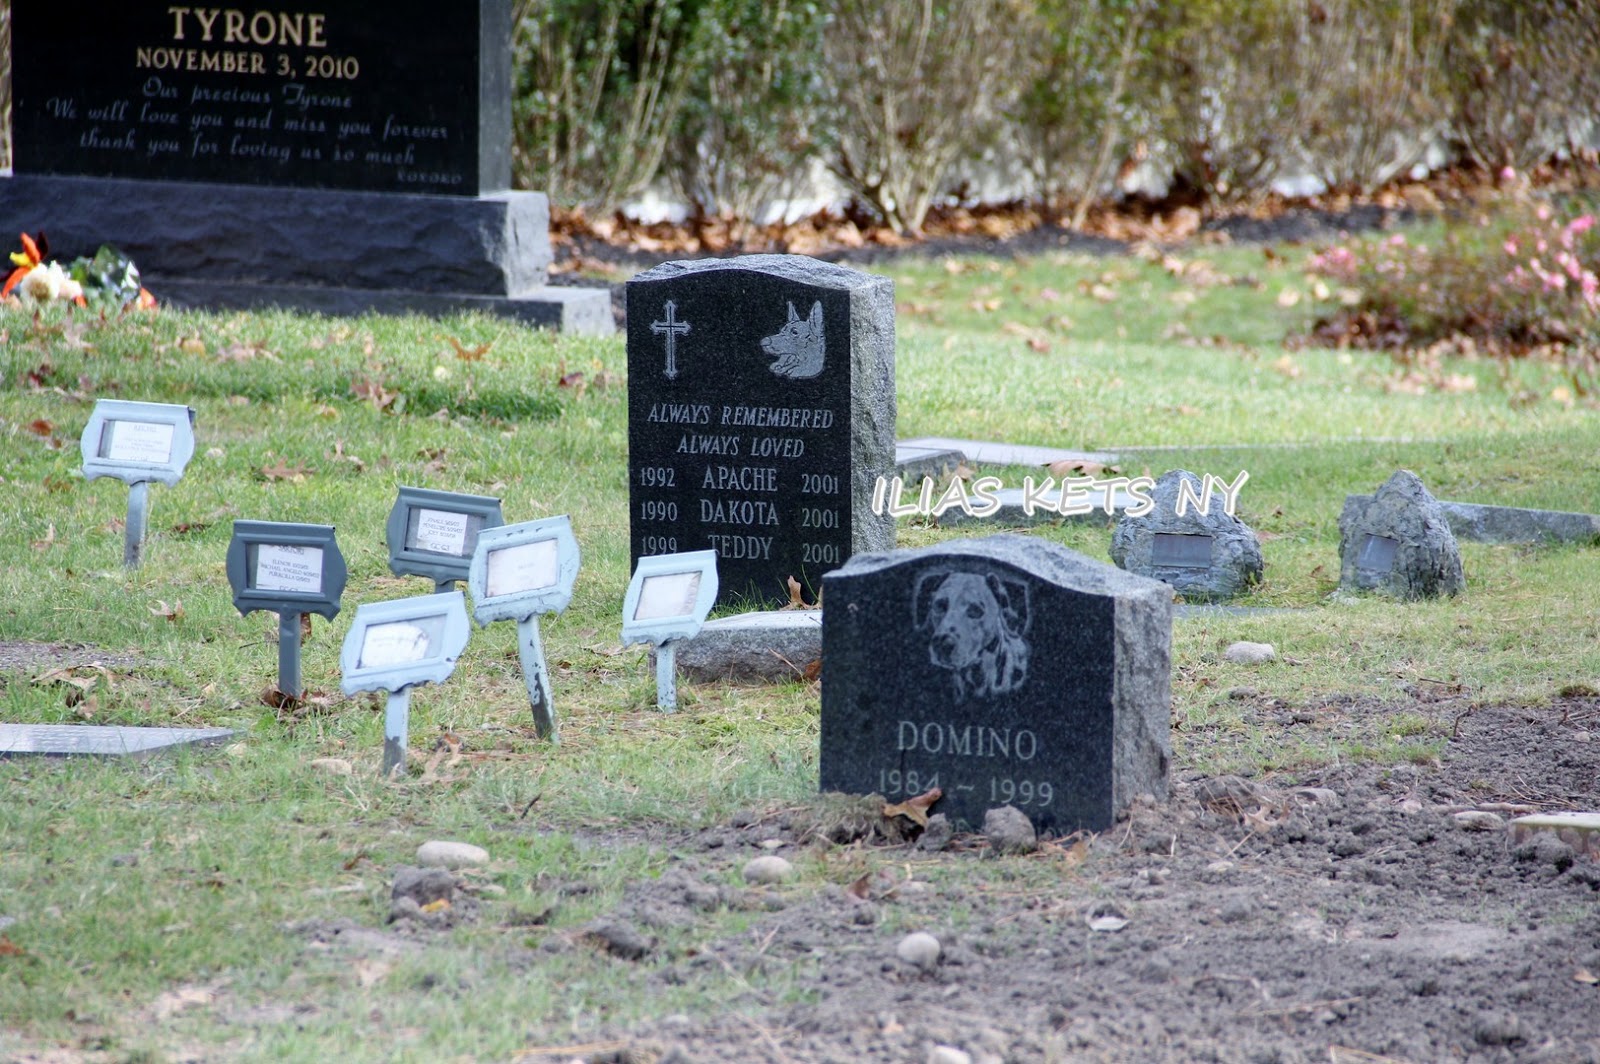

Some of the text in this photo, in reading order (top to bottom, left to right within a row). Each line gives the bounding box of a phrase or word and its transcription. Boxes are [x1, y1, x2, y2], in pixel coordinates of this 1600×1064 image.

[168, 6, 327, 48] TYRONE
[136, 46, 360, 80] NOVEMBER 3, 2010
[142, 76, 353, 112] Our precious Tyrone
[46, 96, 448, 141] We will love you and miss you forever
[79, 127, 415, 165] thank you for loving us so much
[646, 403, 834, 429] ALWAYS REMEMBERED
[676, 434, 805, 458] ALWAYS LOVED
[640, 464, 839, 495] 1992 APACHE 2001
[641, 498, 839, 529] 1990 DAKOTA 2001
[642, 534, 840, 564] 1999 TEDDY 2001
[897, 720, 1037, 760] DOMINO
[878, 768, 940, 797] 1984
[990, 776, 1054, 807] 1999
